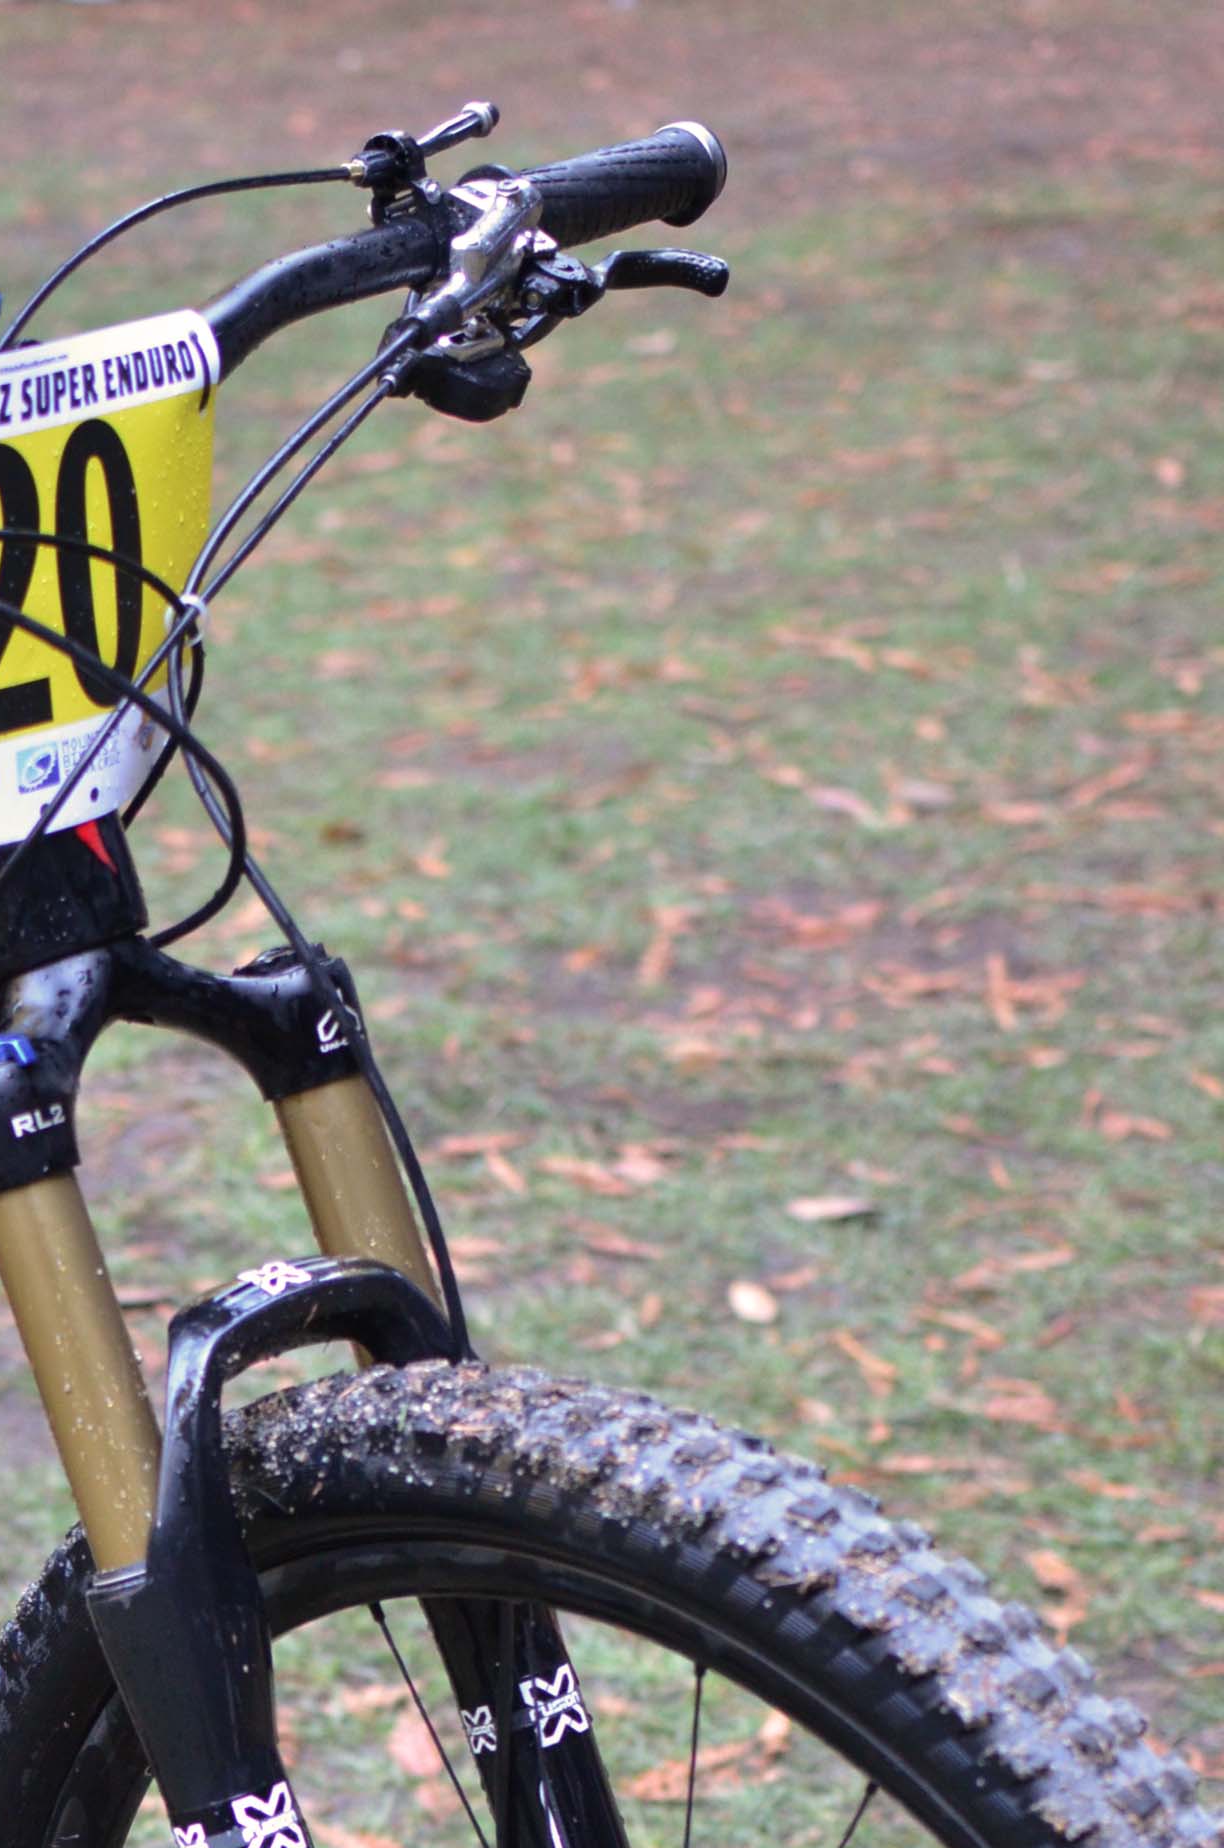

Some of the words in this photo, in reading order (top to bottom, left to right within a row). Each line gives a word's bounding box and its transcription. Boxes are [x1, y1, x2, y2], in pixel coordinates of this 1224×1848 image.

[21, 363, 98, 421] SUPER
[102, 340, 196, 400] ENDURO
[11, 1104, 66, 1138] RL2
